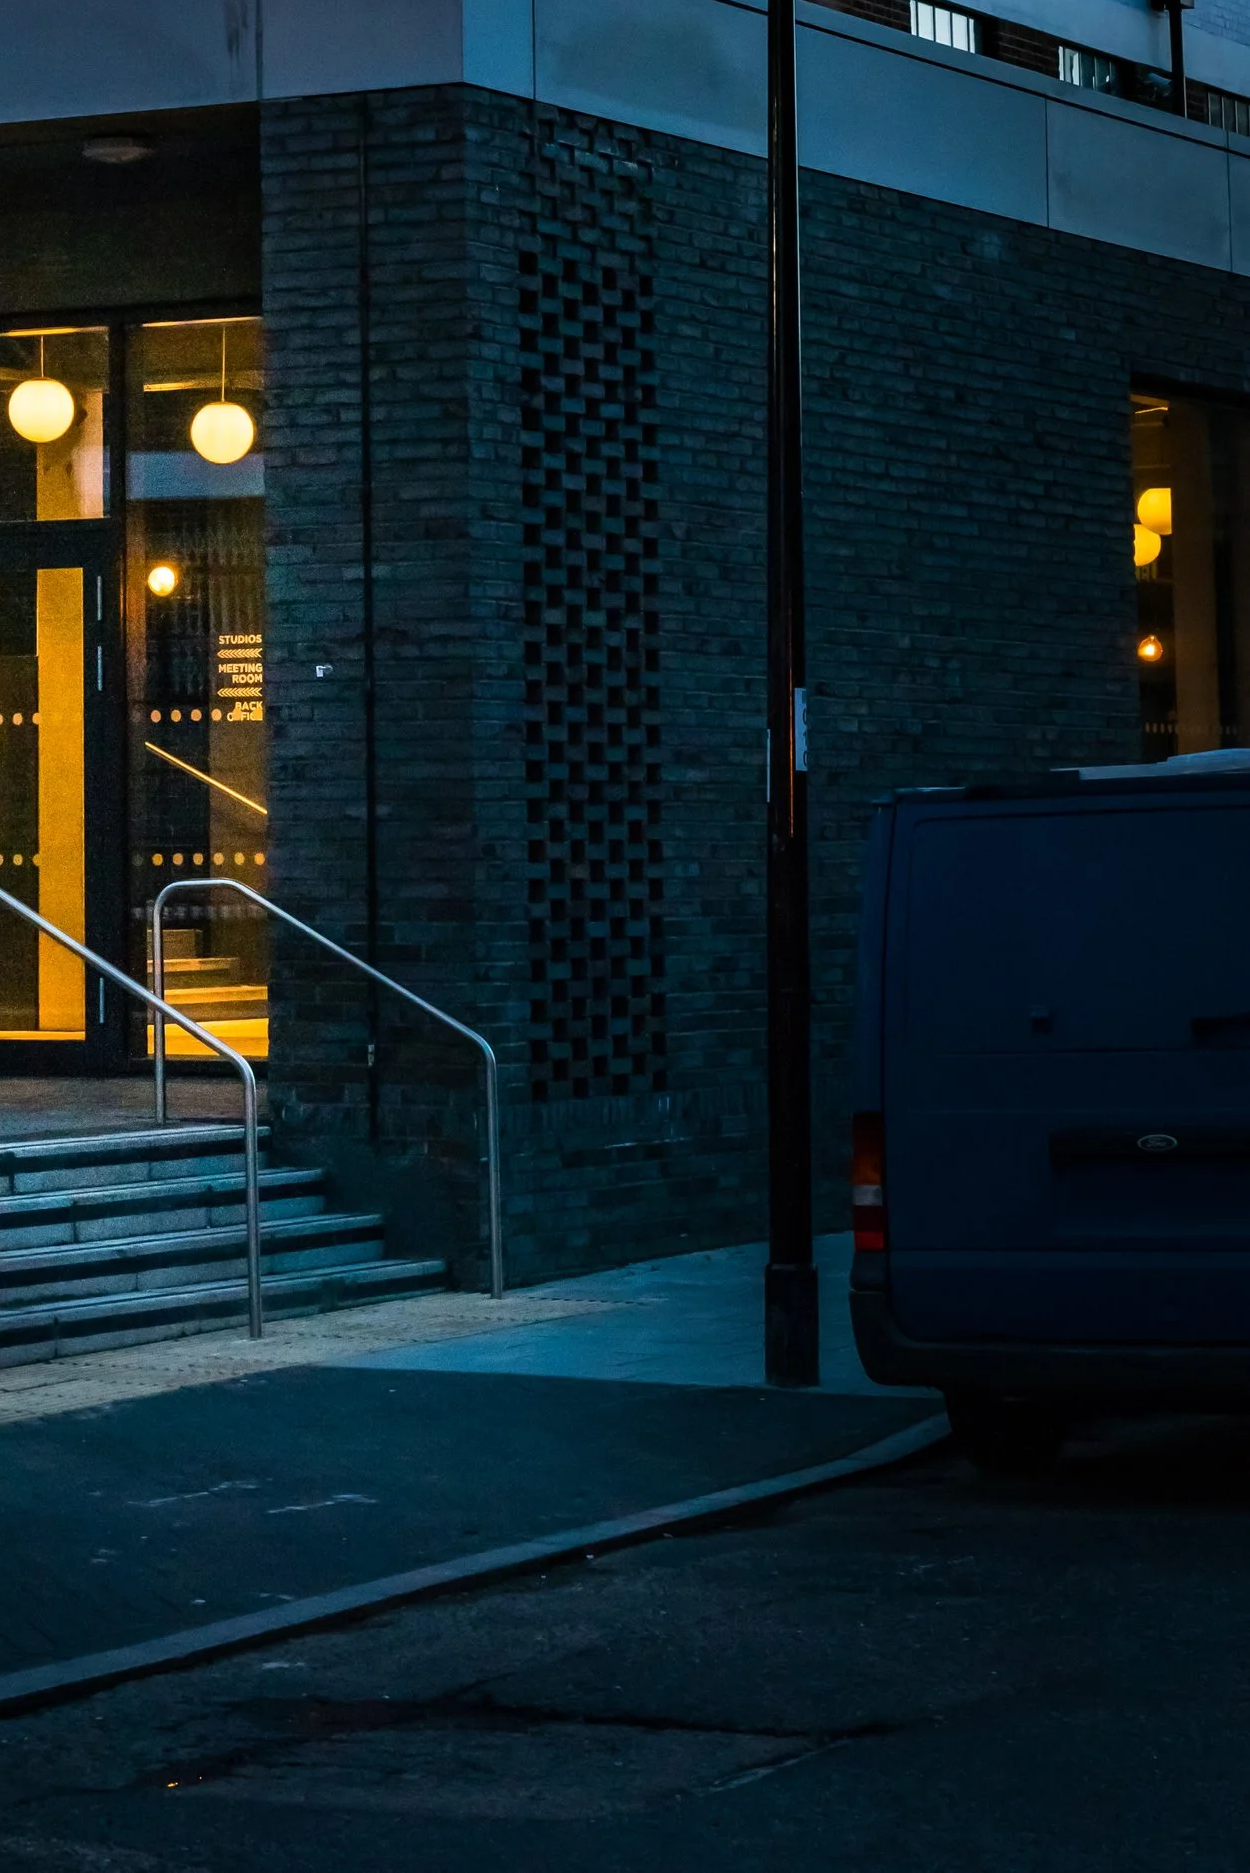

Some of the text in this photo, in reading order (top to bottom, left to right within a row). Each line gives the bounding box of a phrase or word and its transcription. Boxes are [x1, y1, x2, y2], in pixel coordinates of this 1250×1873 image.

[218, 634, 262, 645] STUDIOS
[218, 663, 263, 673] MEETING
[232, 673, 263, 684] ROOM
[235, 701, 263, 711] BACK
[227, 710, 263, 721] OFI
